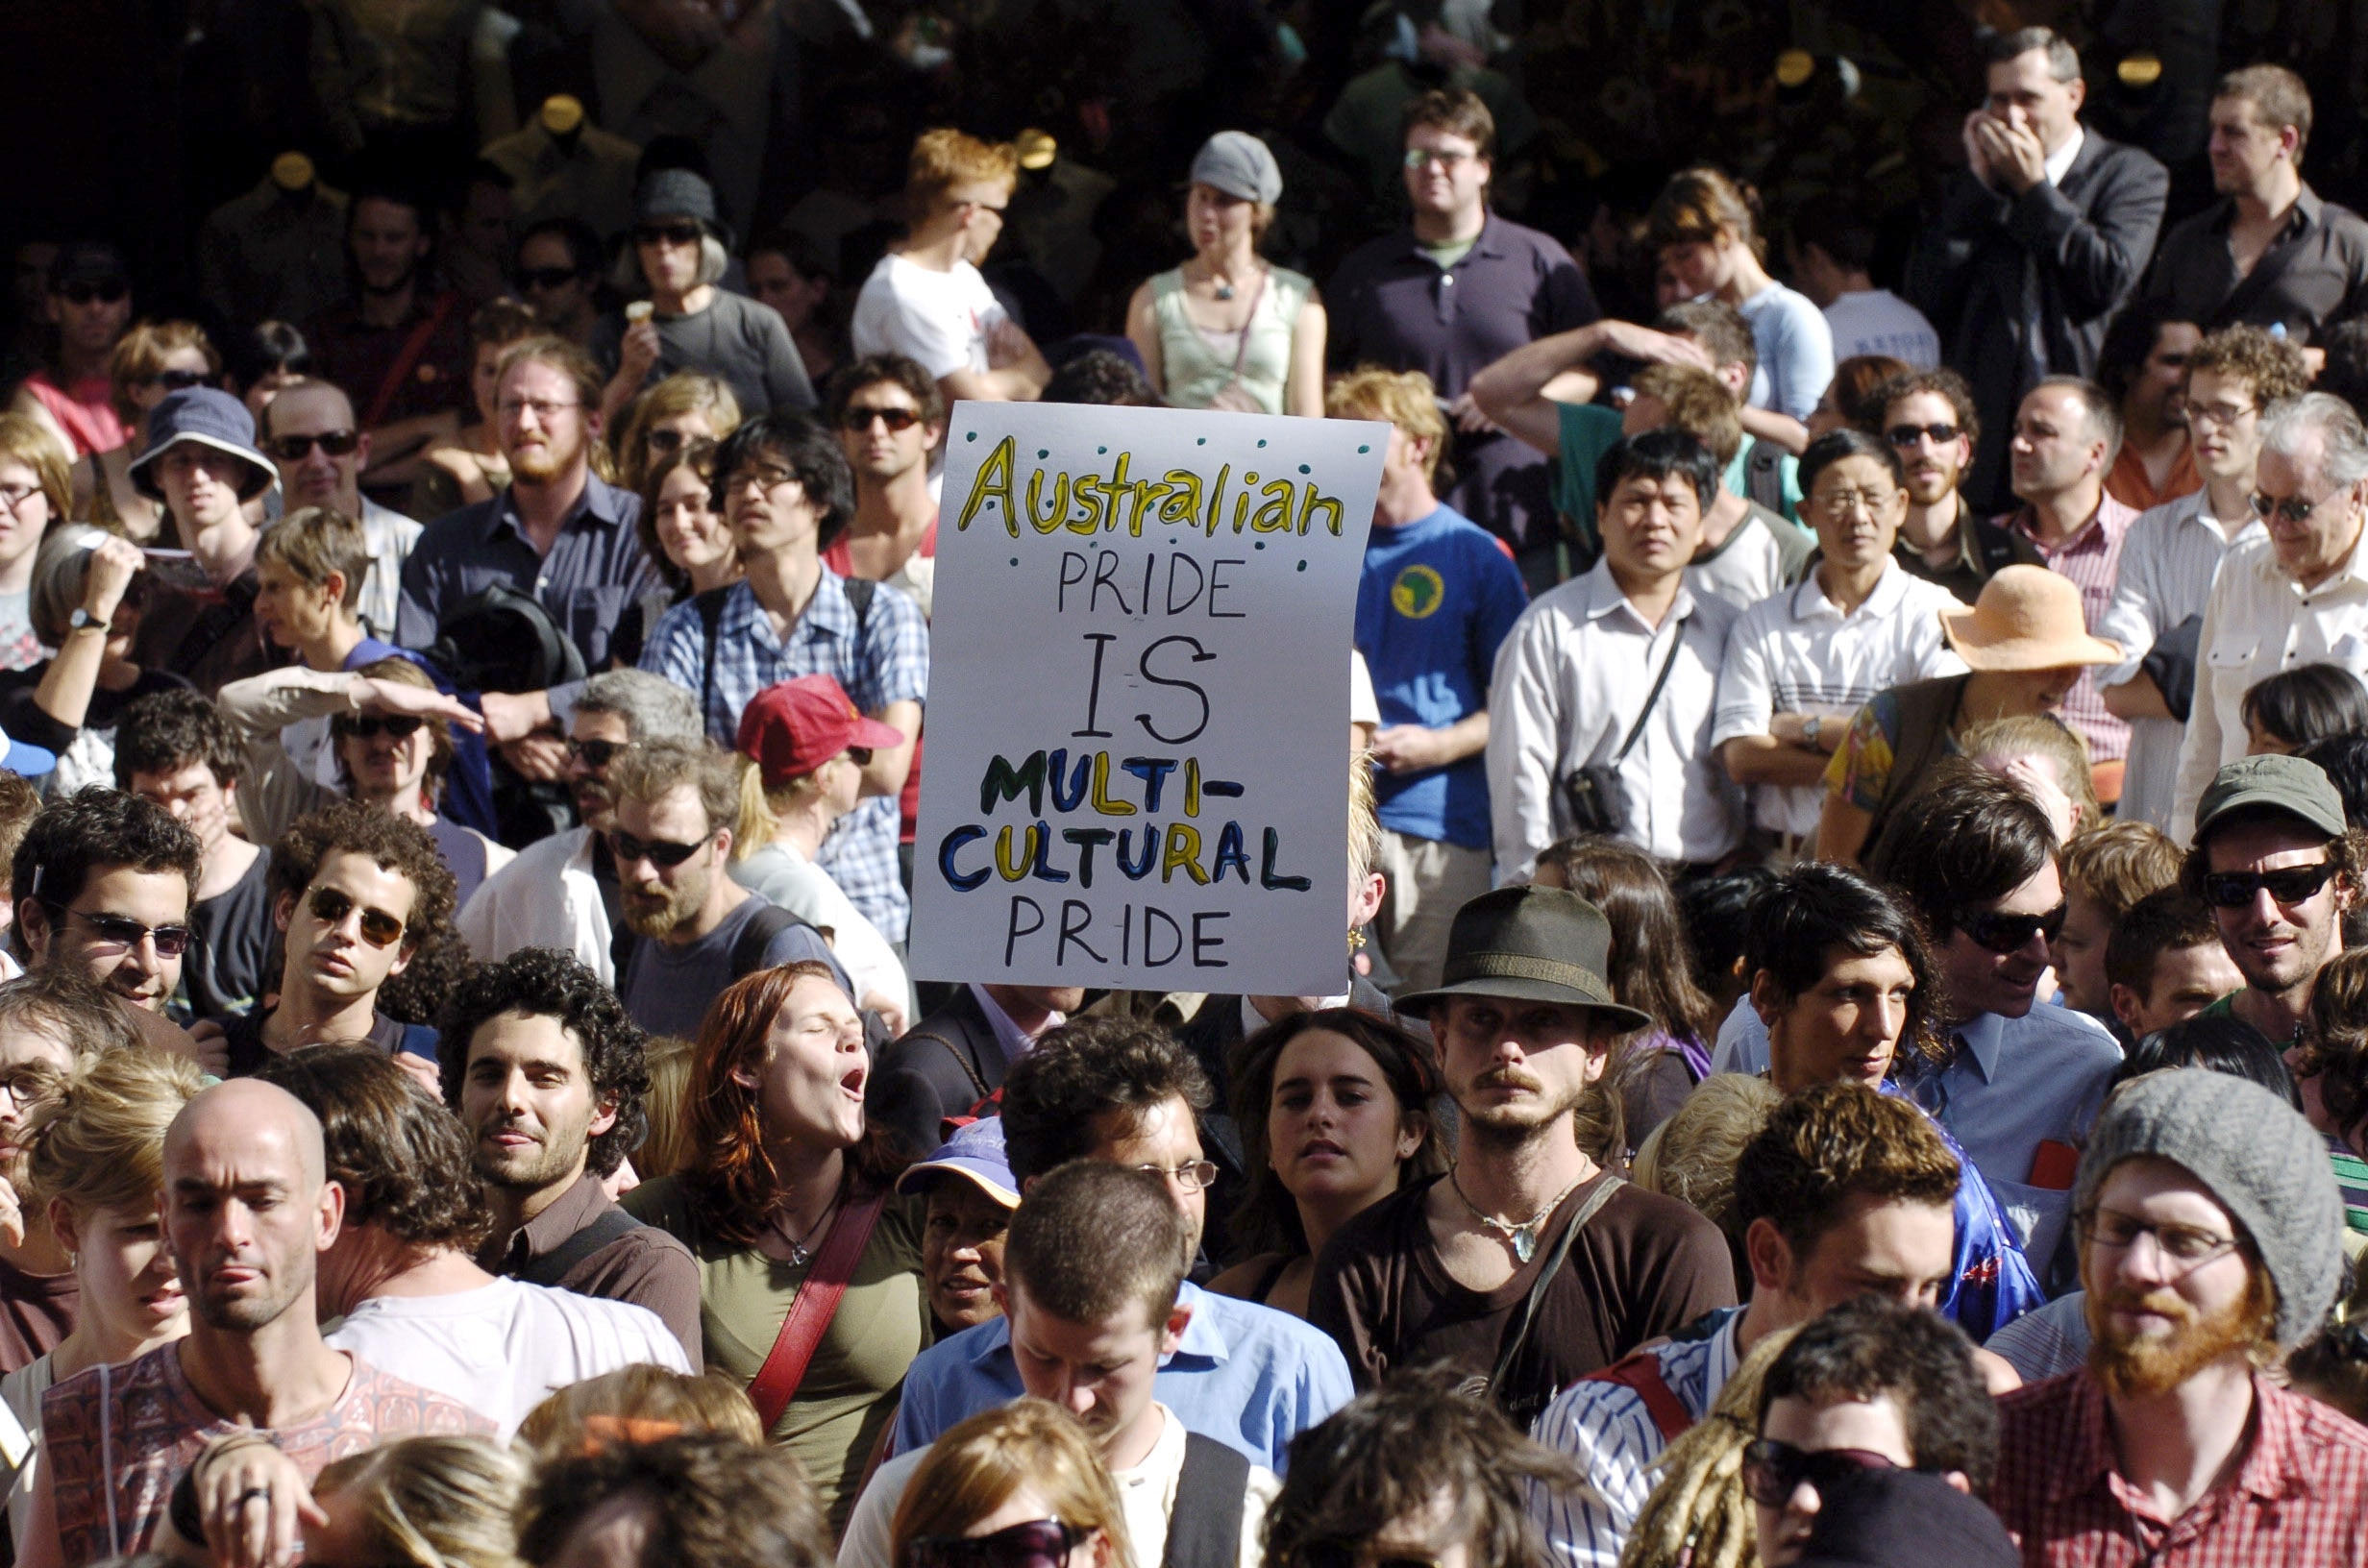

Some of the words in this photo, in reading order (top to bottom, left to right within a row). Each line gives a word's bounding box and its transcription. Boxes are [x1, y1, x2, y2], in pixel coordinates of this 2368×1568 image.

[958, 435, 1344, 538] Australian
[1058, 550, 1246, 617] PRIDE
[1072, 633, 1217, 744] IS
[980, 747, 1245, 817] MULTI-
[938, 821, 1312, 892] CULTURAL
[1005, 894, 1231, 968] PRIDE
